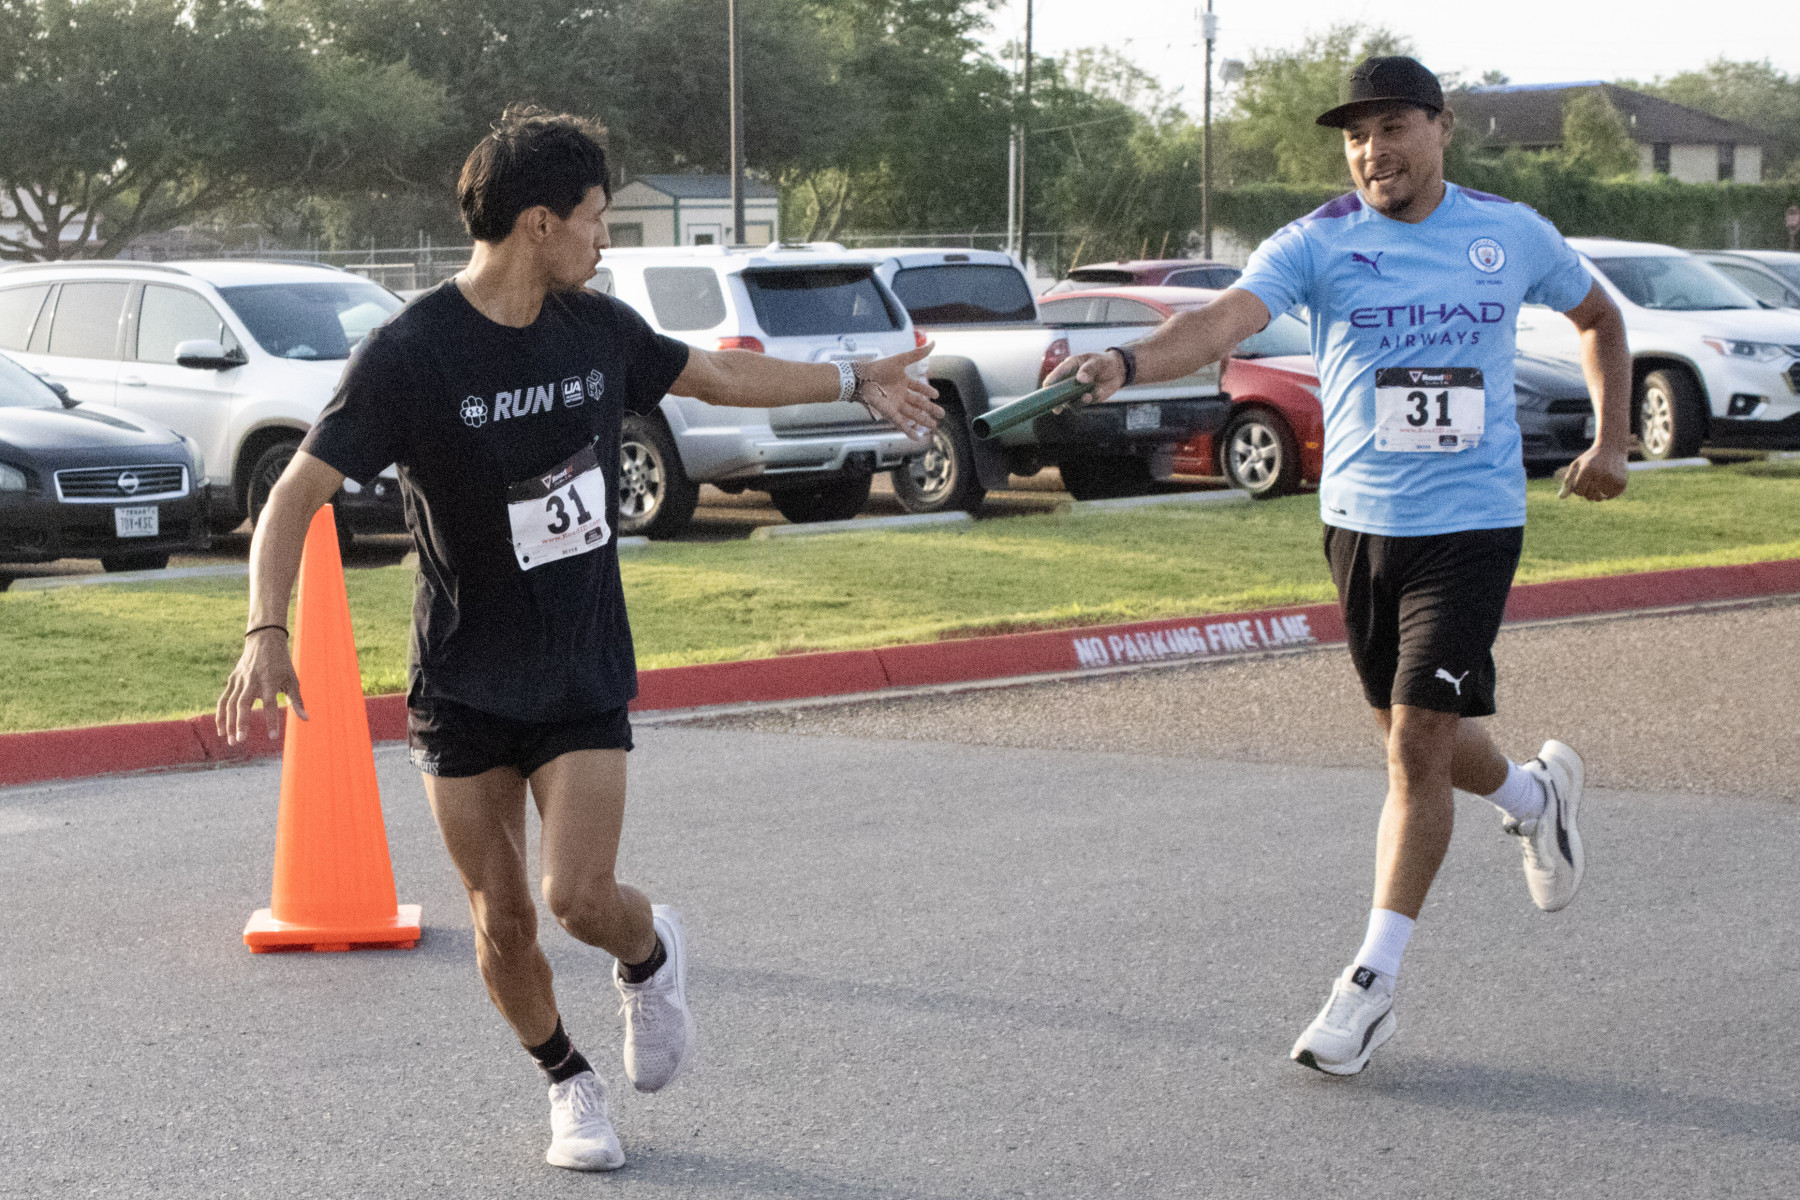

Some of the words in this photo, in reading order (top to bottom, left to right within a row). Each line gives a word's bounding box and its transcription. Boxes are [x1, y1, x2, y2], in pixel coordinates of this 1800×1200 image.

[1350, 302, 1505, 328] ETIHAD
[1379, 331, 1480, 349] AIRWAYS
[493, 383, 554, 421] RUN
[1406, 390, 1452, 427] 31
[545, 484, 592, 535] 31
[1073, 637, 1110, 665] NO
[1108, 627, 1208, 662] PARKING
[1205, 619, 1258, 650] FIRE
[1255, 614, 1315, 646] LANE
